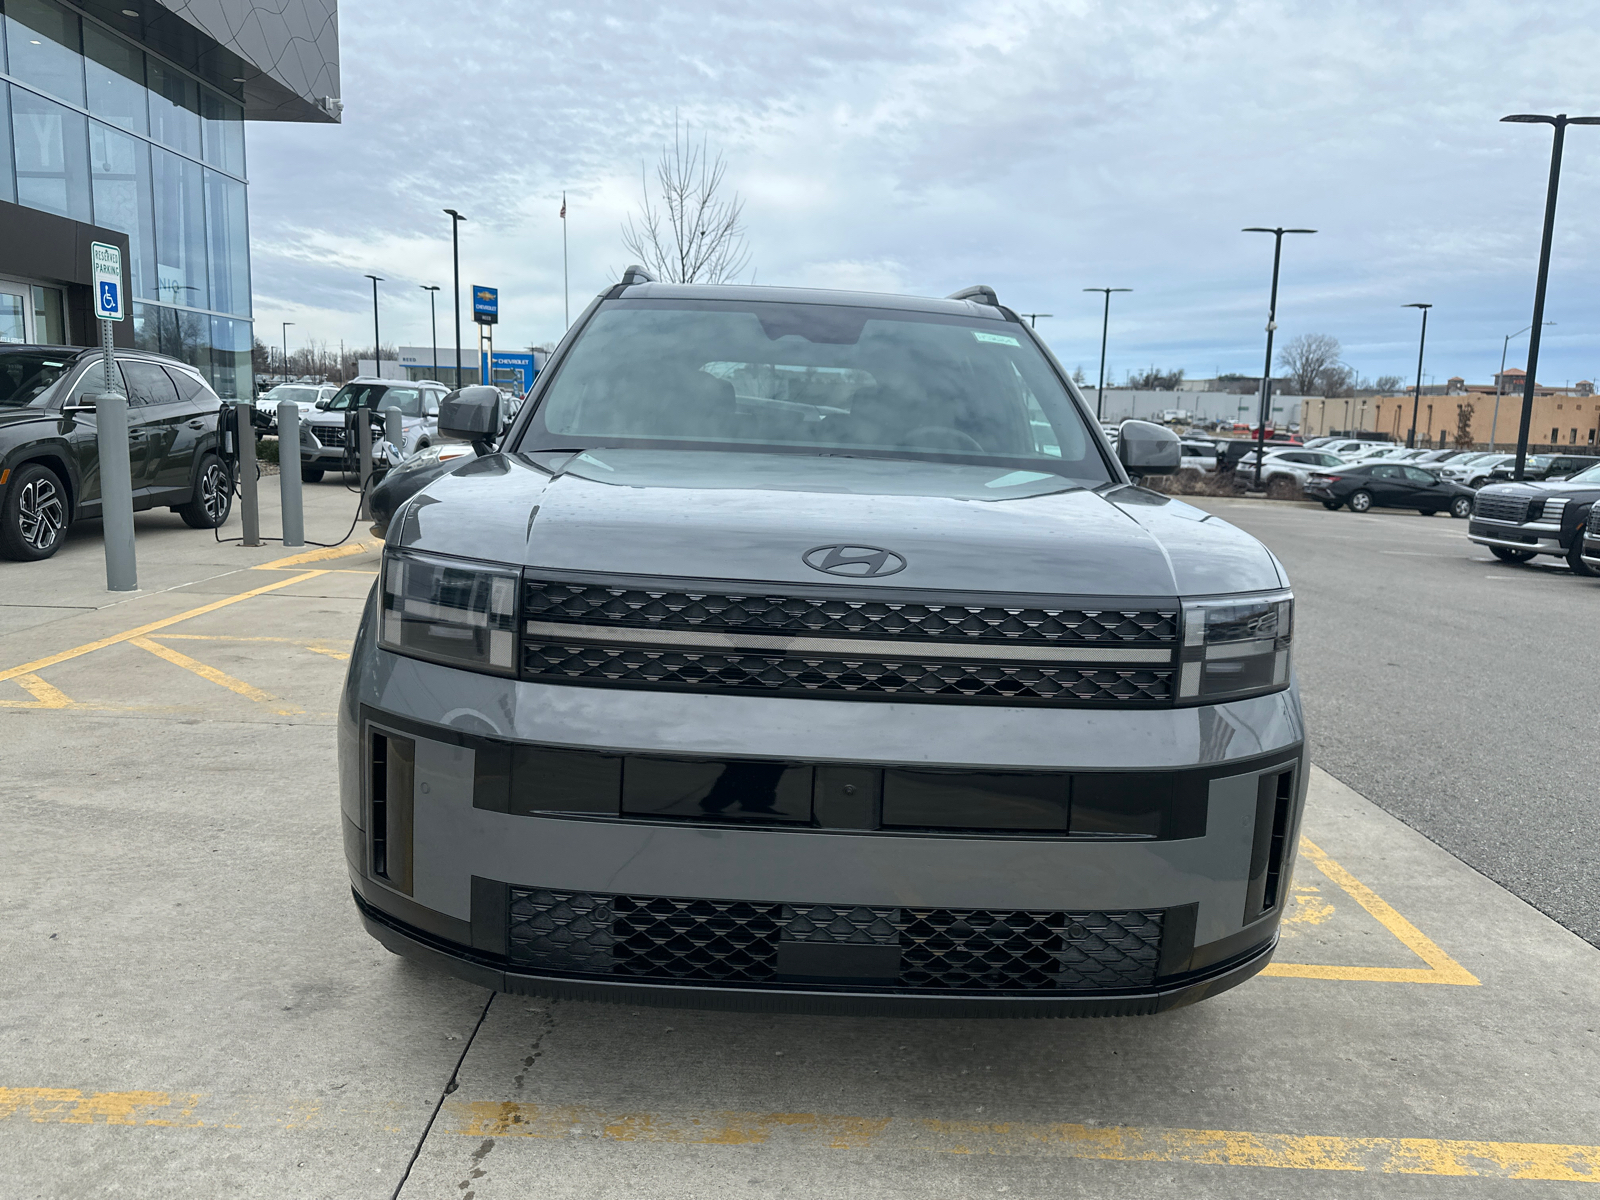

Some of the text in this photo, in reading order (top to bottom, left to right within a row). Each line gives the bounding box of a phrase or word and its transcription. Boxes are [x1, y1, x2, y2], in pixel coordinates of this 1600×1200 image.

[95, 250, 119, 264] RESERVED
[95, 262, 120, 277] PARKING
[475, 303, 497, 312] CHEVROLET
